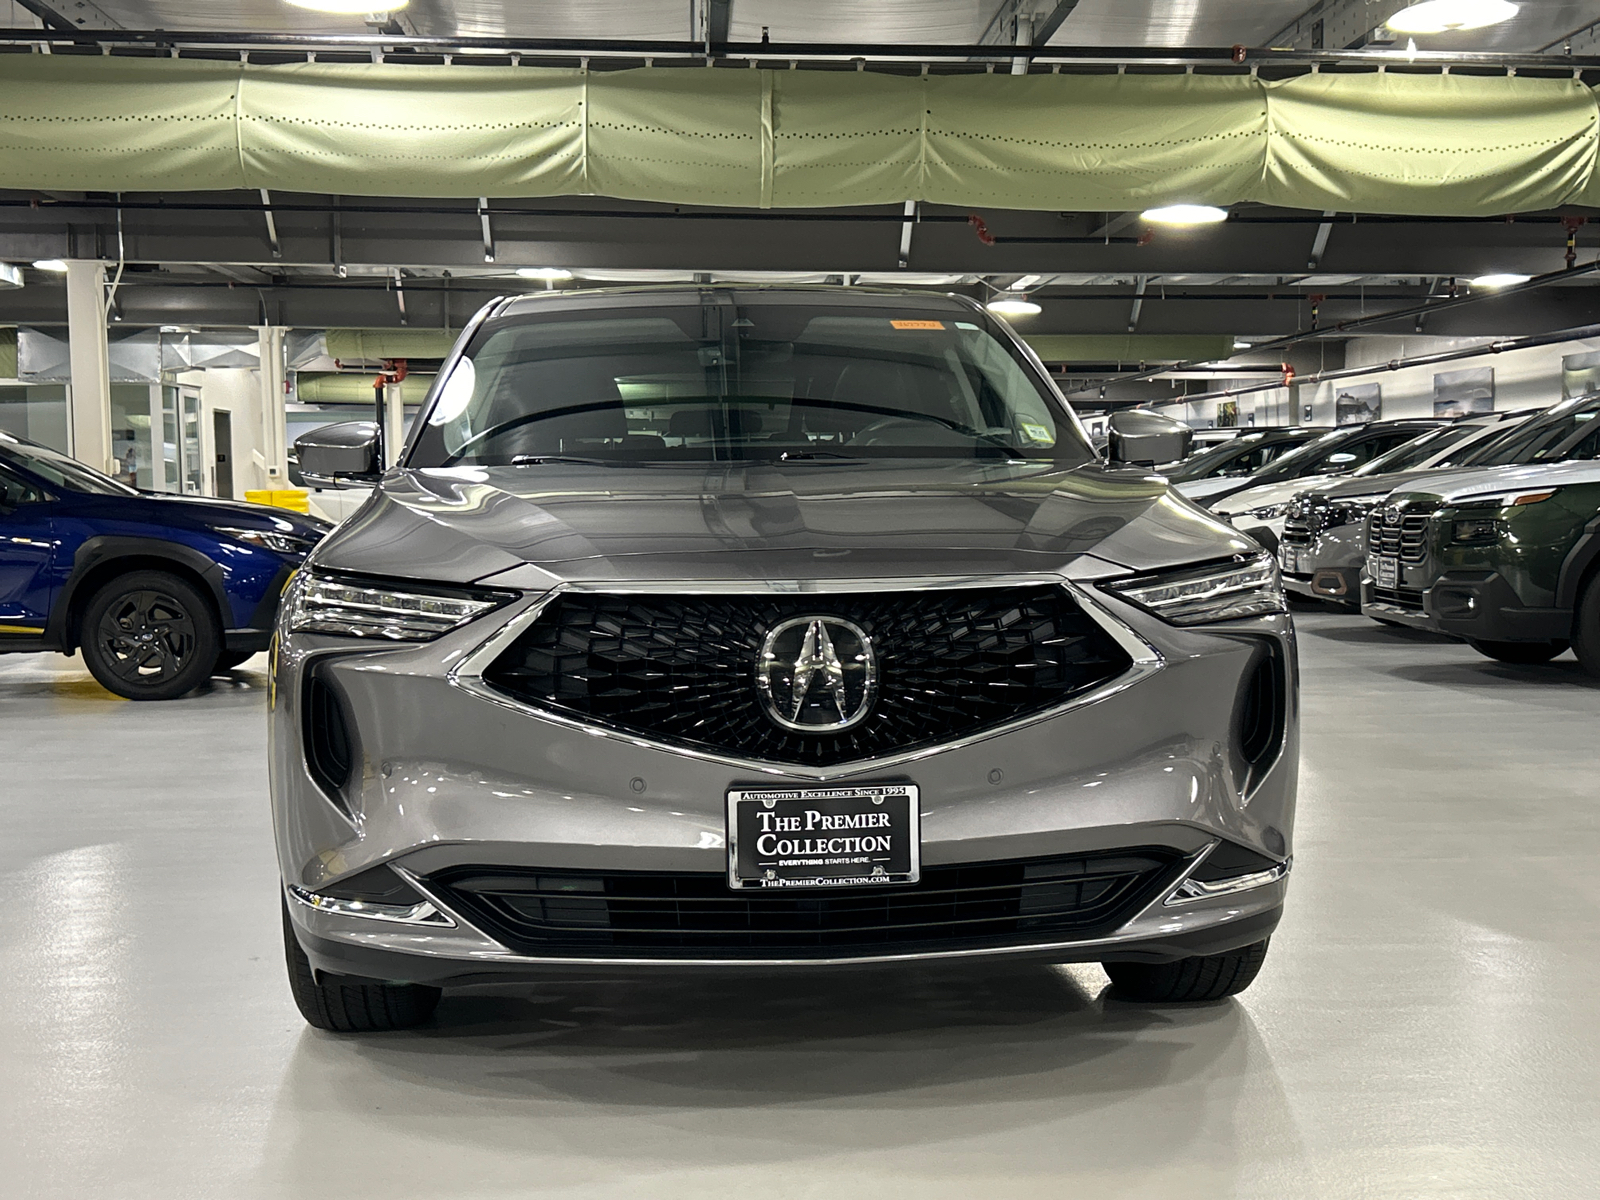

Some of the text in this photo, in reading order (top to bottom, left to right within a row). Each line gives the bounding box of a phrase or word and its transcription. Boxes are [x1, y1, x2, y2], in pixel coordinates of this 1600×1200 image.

[882, 787, 905, 795] 1995
[756, 810, 891, 832] THE PREMIER
[756, 833, 891, 856] COLLECTION
[778, 859, 823, 867] EVERYTHING
[824, 857, 850, 865] STARTS
